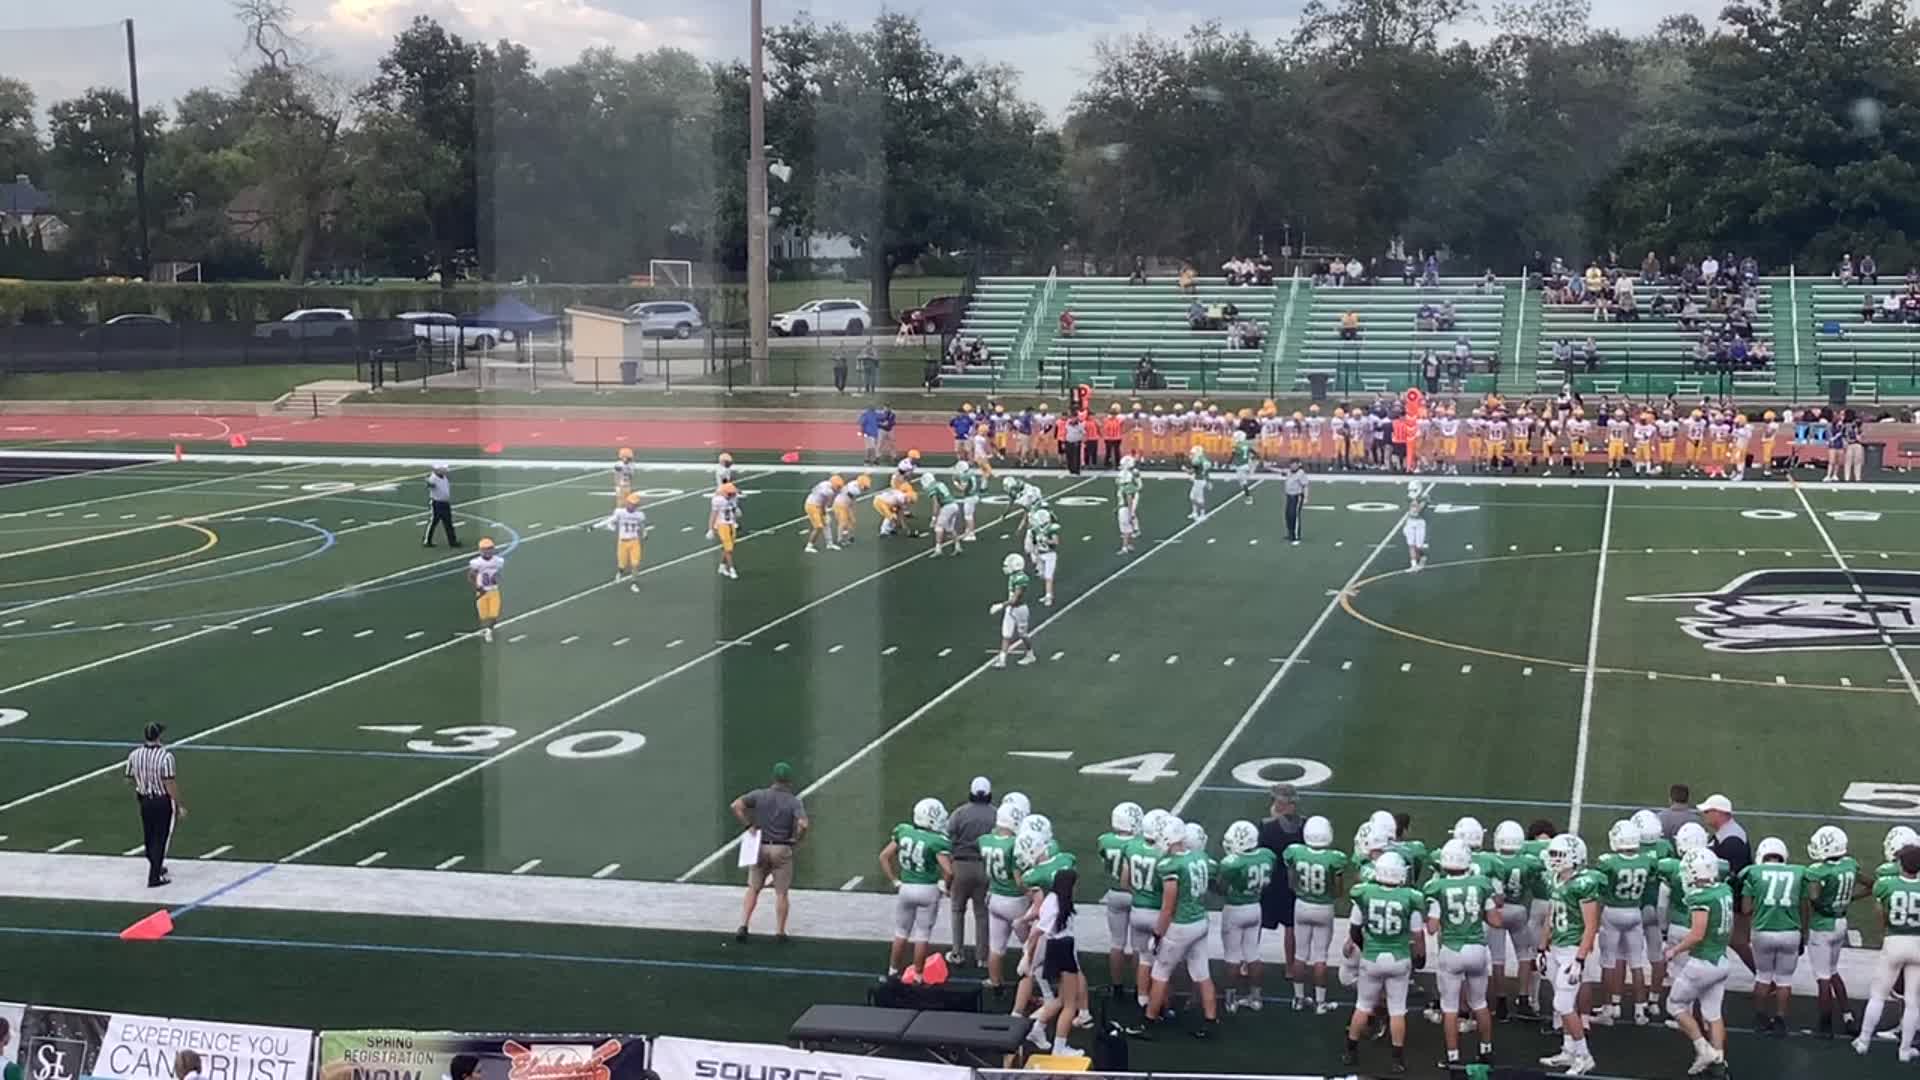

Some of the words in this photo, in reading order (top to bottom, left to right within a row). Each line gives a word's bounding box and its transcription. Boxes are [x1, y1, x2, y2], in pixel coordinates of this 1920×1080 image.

[897, 836, 926, 873] 24
[980, 845, 1009, 880] 72
[1130, 854, 1157, 892] 67
[1295, 861, 1326, 895] 38
[1762, 870, 1795, 907] 77
[1832, 871, 1855, 909] 10
[1367, 898, 1403, 936] 56
[1446, 885, 1481, 925] 54
[1889, 890, 1920, 928] 85
[120, 1023, 242, 1053] EXPERIENCE
[247, 1035, 289, 1057] YOU
[343, 1049, 435, 1065] REGISTRATION
[367, 1036, 414, 1049] SPRING
[109, 1044, 177, 1080] CAN
[200, 1052, 297, 1080] RUST
